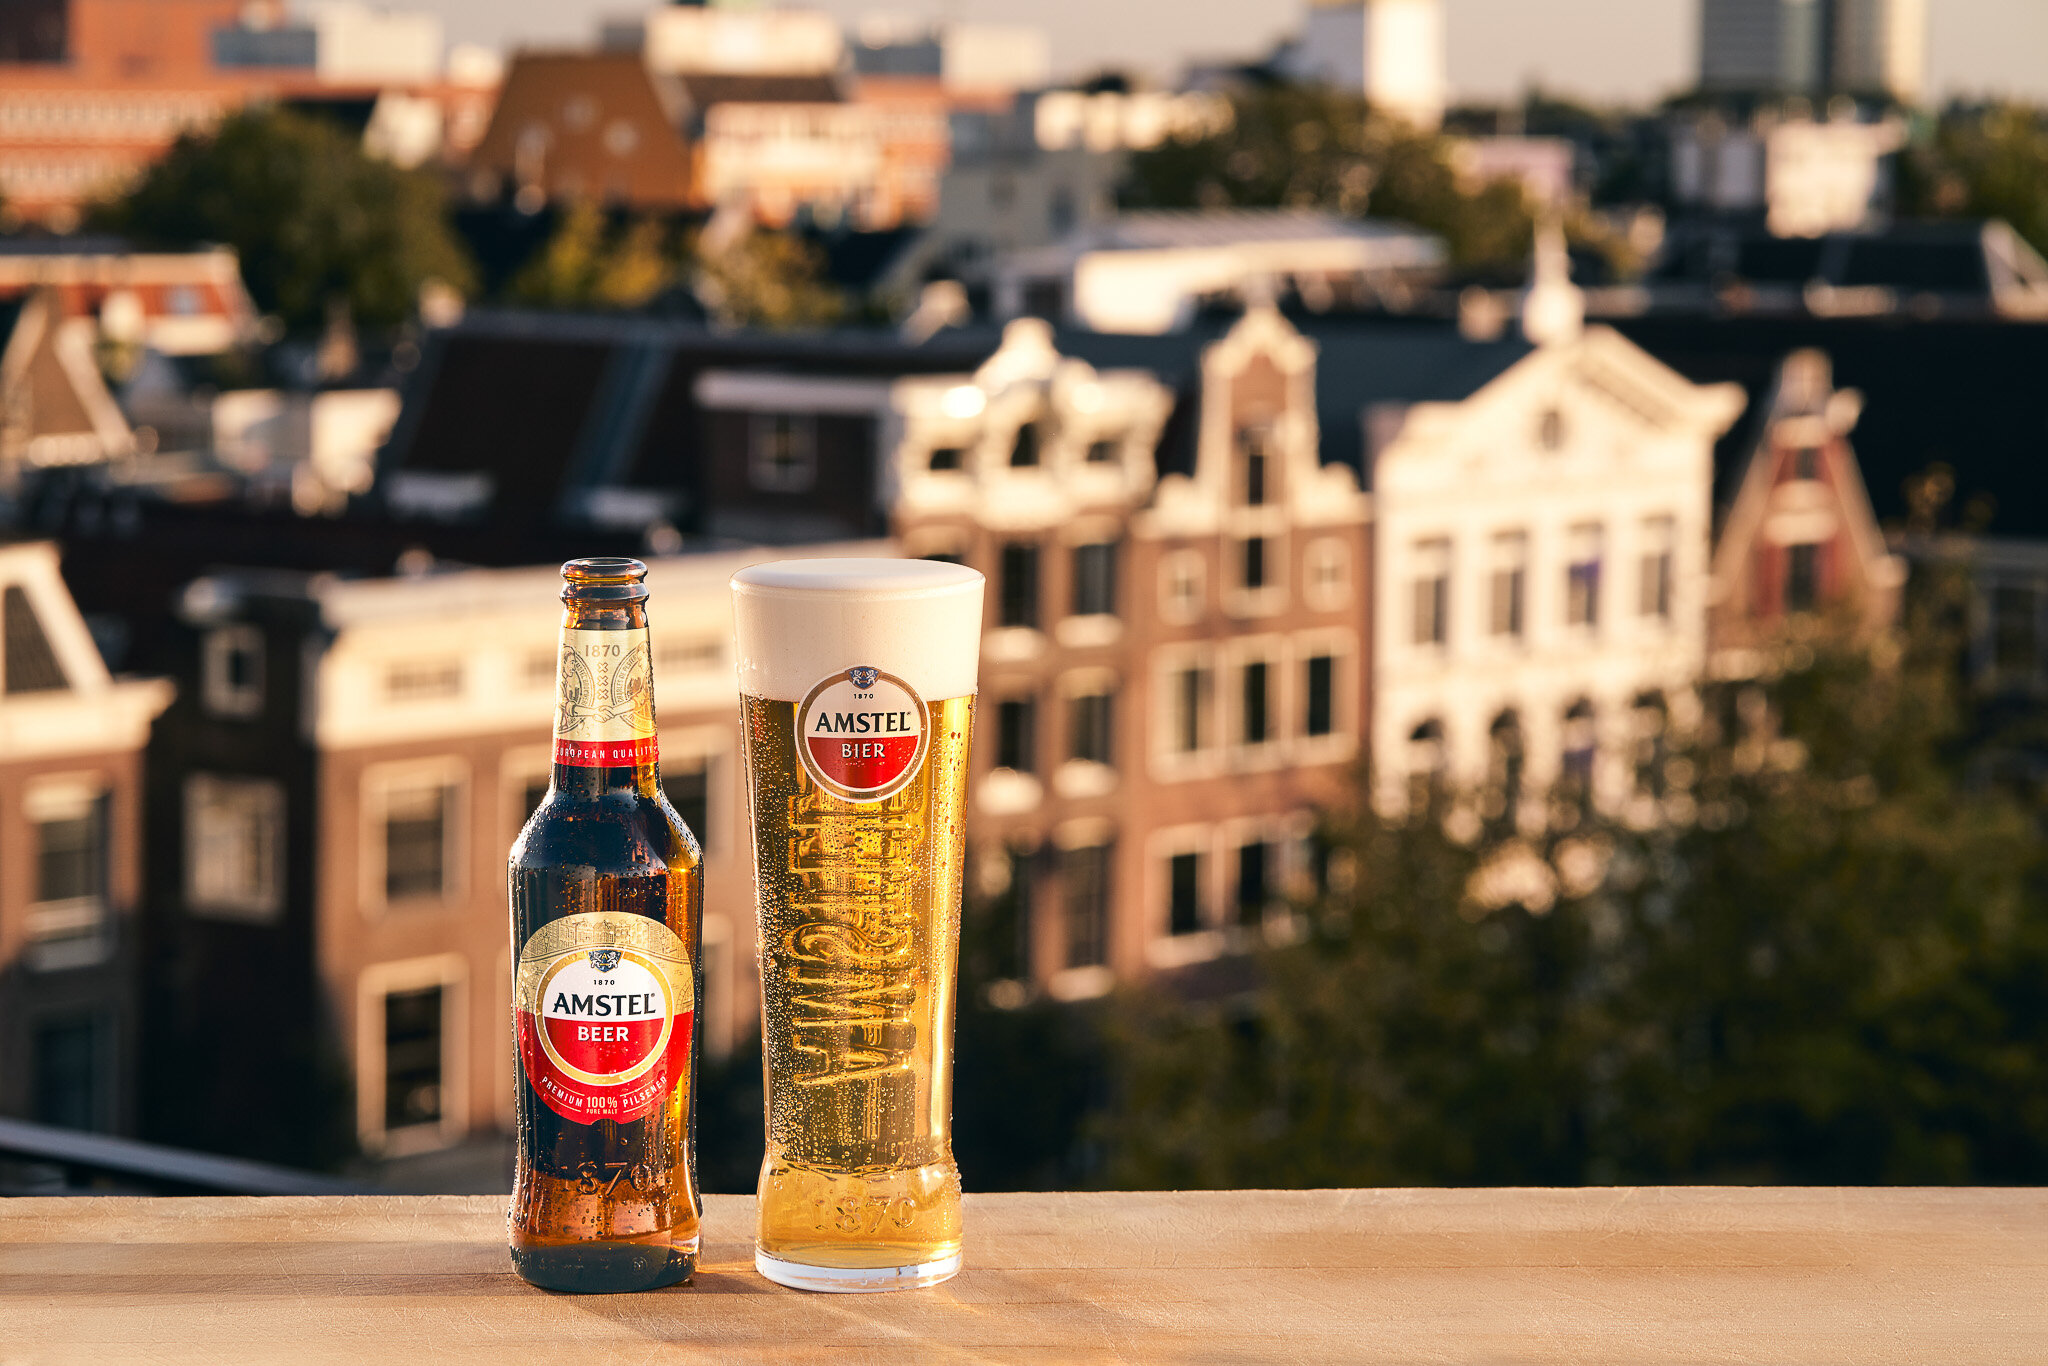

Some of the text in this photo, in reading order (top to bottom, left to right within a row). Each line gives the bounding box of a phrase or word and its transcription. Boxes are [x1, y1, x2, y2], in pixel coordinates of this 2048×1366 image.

[585, 644, 621, 657] 1870
[814, 711, 911, 733] AMSTEL
[555, 746, 605, 759] EUROPEAN
[841, 743, 886, 758] BIER
[552, 992, 656, 1017] AMSTEL
[577, 1026, 630, 1042] BEER
[541, 1076, 583, 1108] PREMIUM
[623, 1076, 667, 1108] PILSENER
